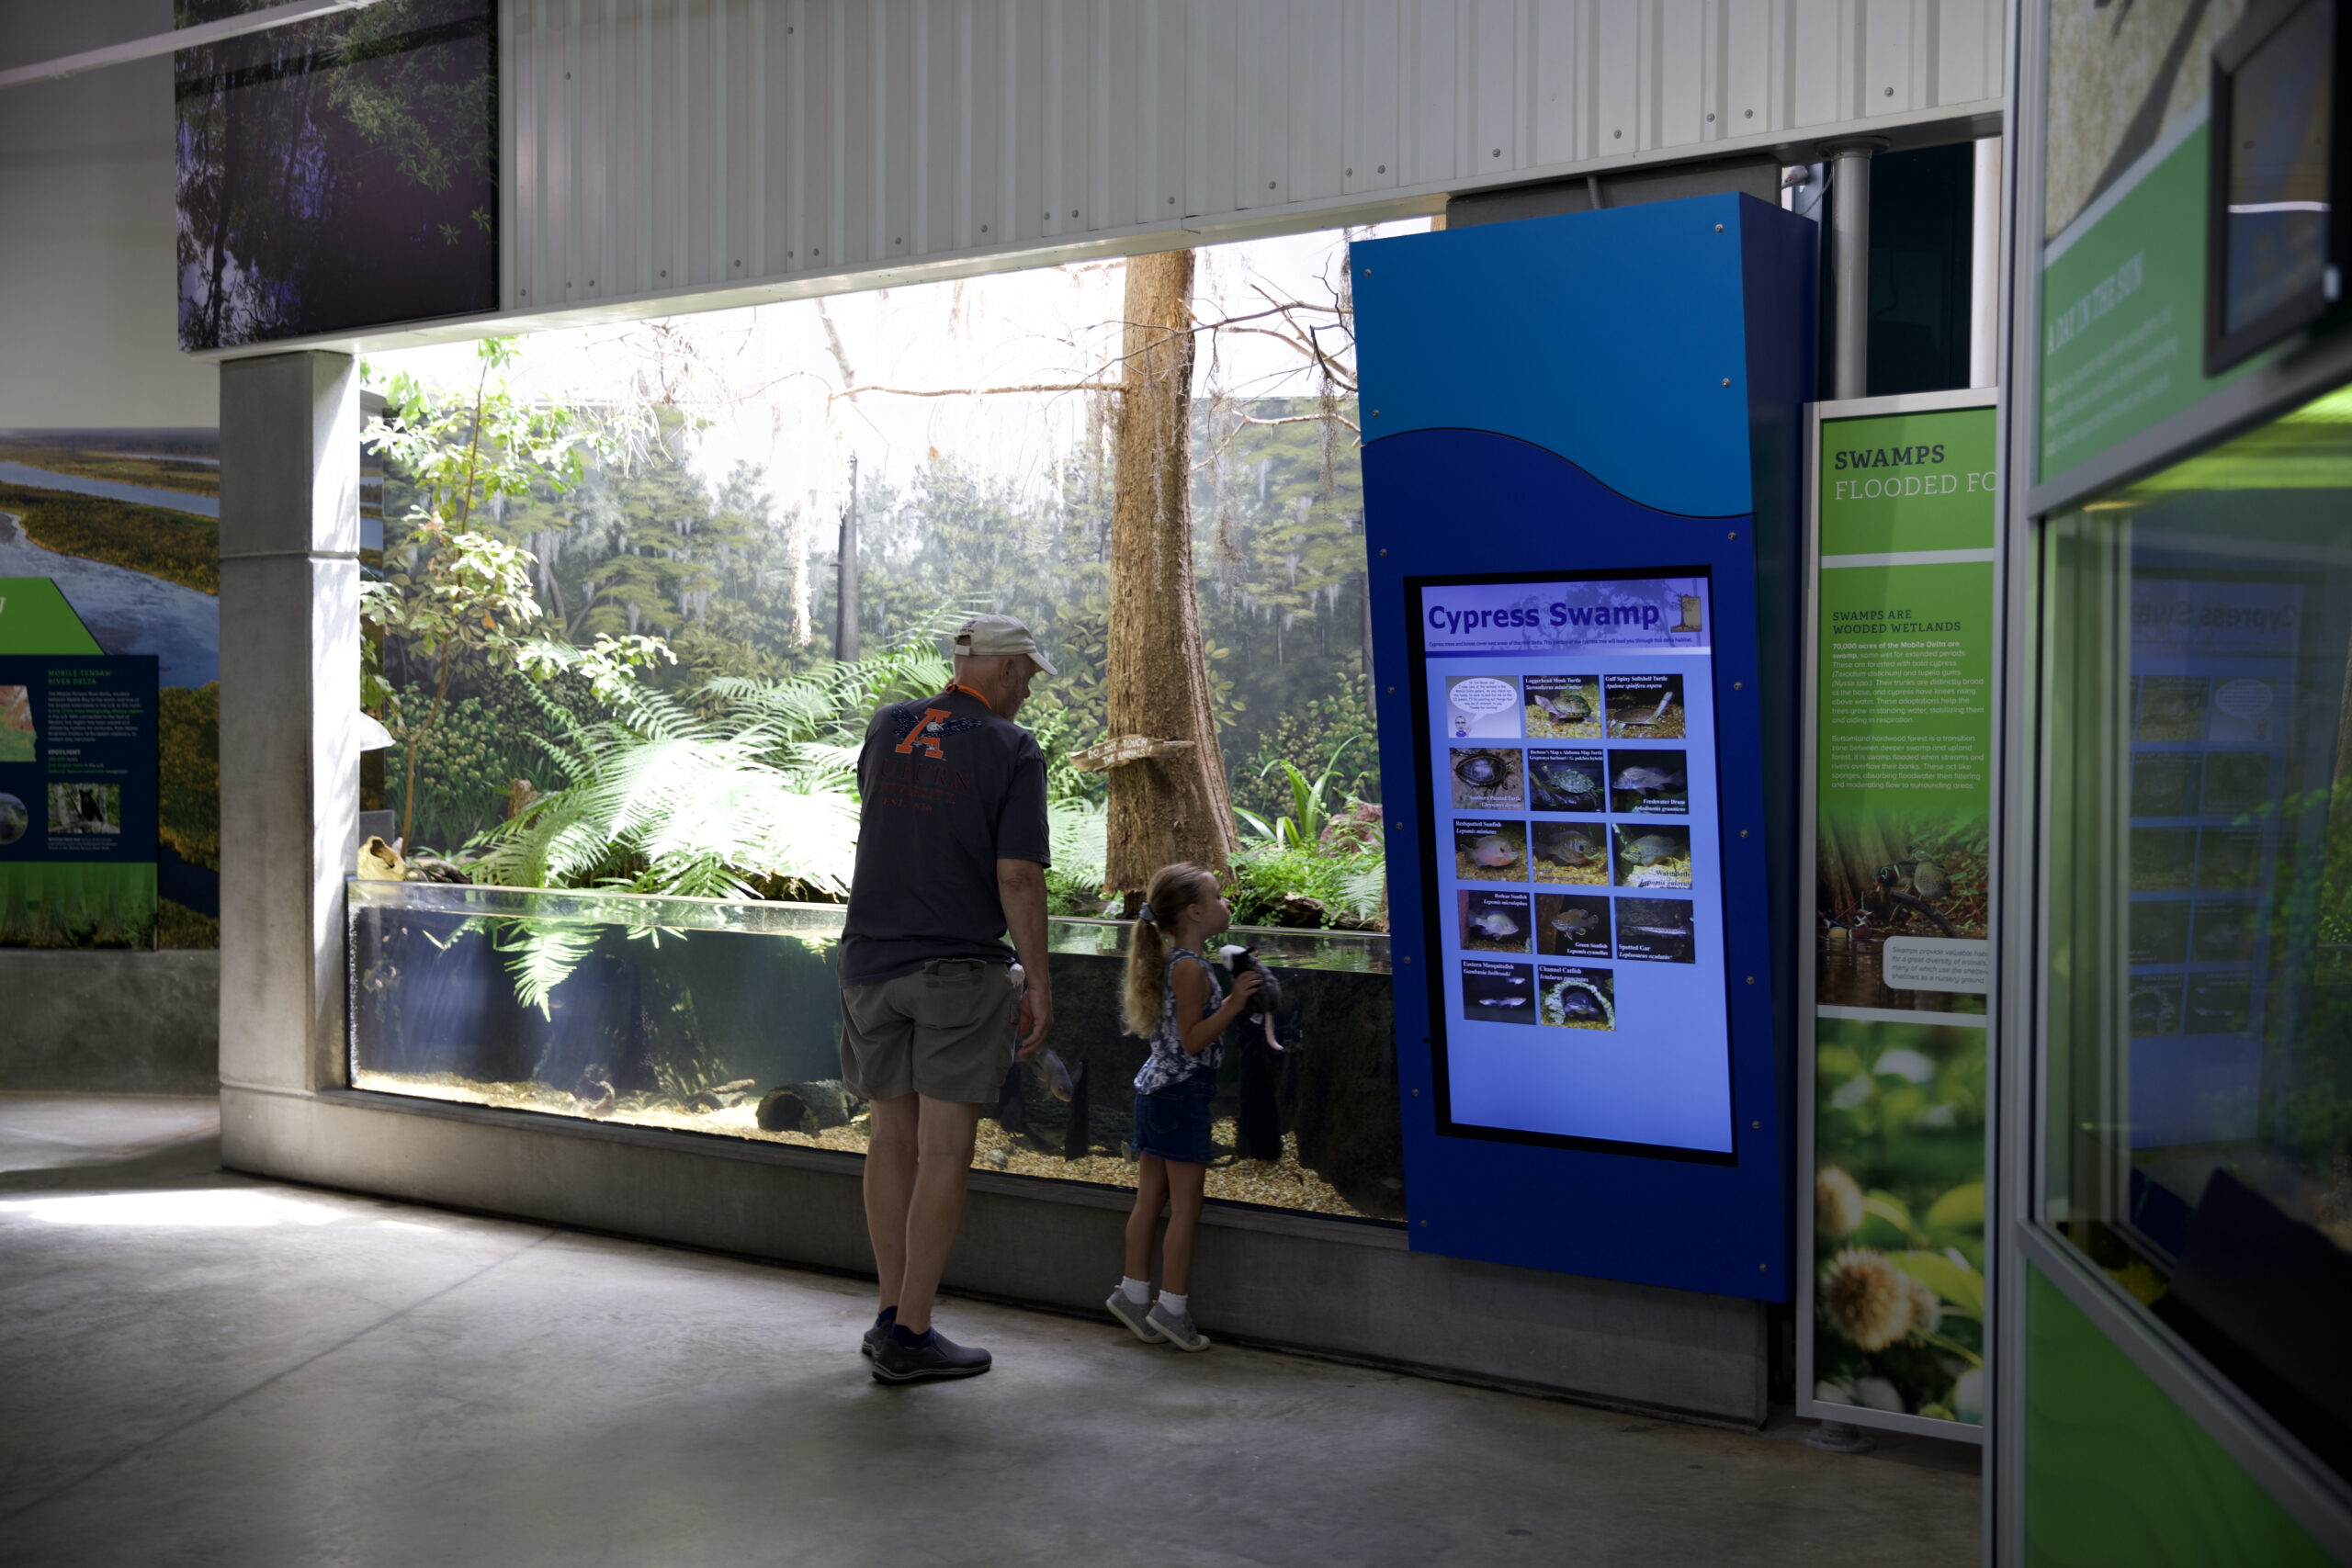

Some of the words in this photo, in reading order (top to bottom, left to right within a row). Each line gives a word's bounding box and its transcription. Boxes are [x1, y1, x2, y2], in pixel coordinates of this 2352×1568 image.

[1835, 445, 1945, 470] SWAMPS
[1835, 474, 1958, 501] FLOODED
[1967, 471, 1997, 492] FO
[1428, 605, 1541, 635] Cypress
[1548, 603, 1660, 631] Swamp
[1832, 611, 1884, 621] SWAMPS
[1888, 610, 1912, 619] ARE
[1833, 624, 1887, 634] WOODED
[1891, 622, 1962, 632] WETLANDS
[1898, 697, 1939, 705] adaptations
[1940, 697, 1957, 705] help
[1877, 706, 1905, 716] standing
[1088, 749, 1100, 760] DO
[1104, 741, 1117, 753] NOT
[1122, 738, 1148, 749] TOUCH
[1881, 744, 1904, 752] deeper
[1948, 744, 1973, 752] upland
[1102, 755, 1115, 765] THE
[1925, 957, 1952, 965] diversity
